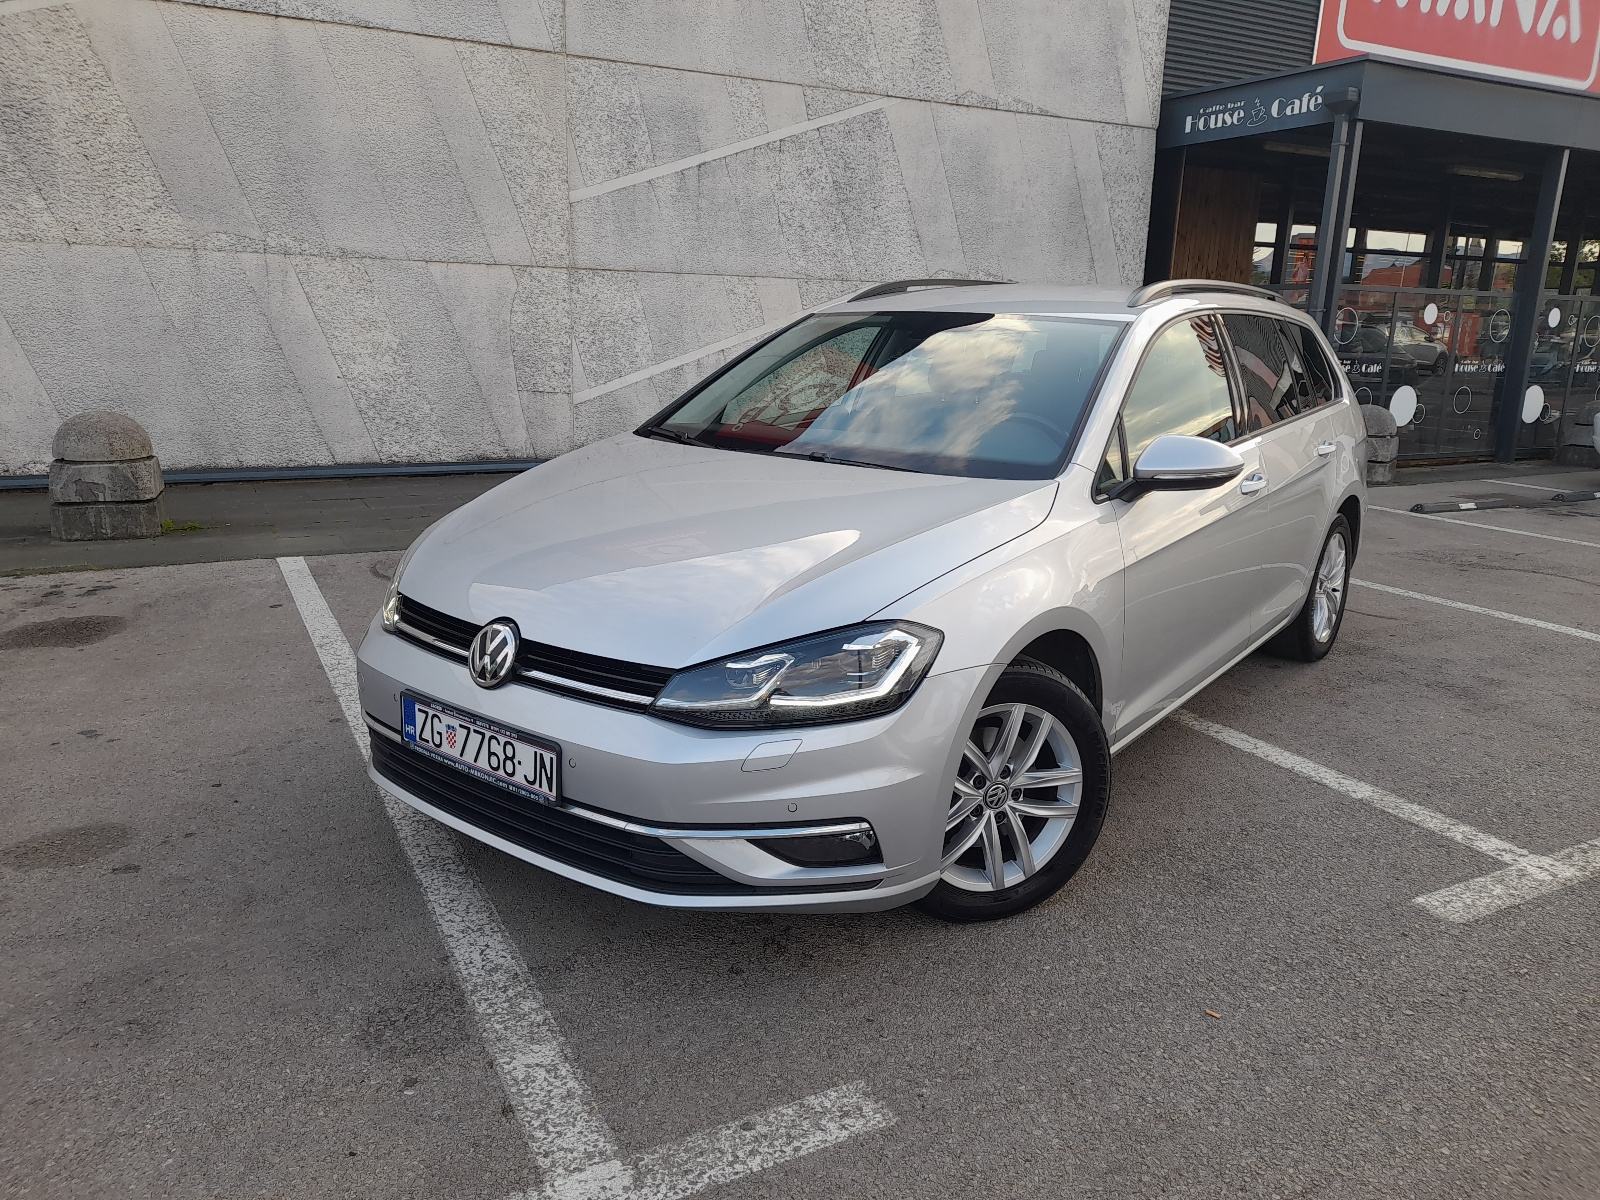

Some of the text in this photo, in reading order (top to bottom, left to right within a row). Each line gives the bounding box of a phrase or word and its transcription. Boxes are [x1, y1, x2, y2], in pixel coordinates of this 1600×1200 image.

[1184, 85, 1325, 134] House Café
[1228, 100, 1246, 109] bar
[1361, 362, 1382, 373] Café
[1455, 363, 1479, 372] House
[405, 725, 416, 737] HR
[417, 707, 443, 749] ZG
